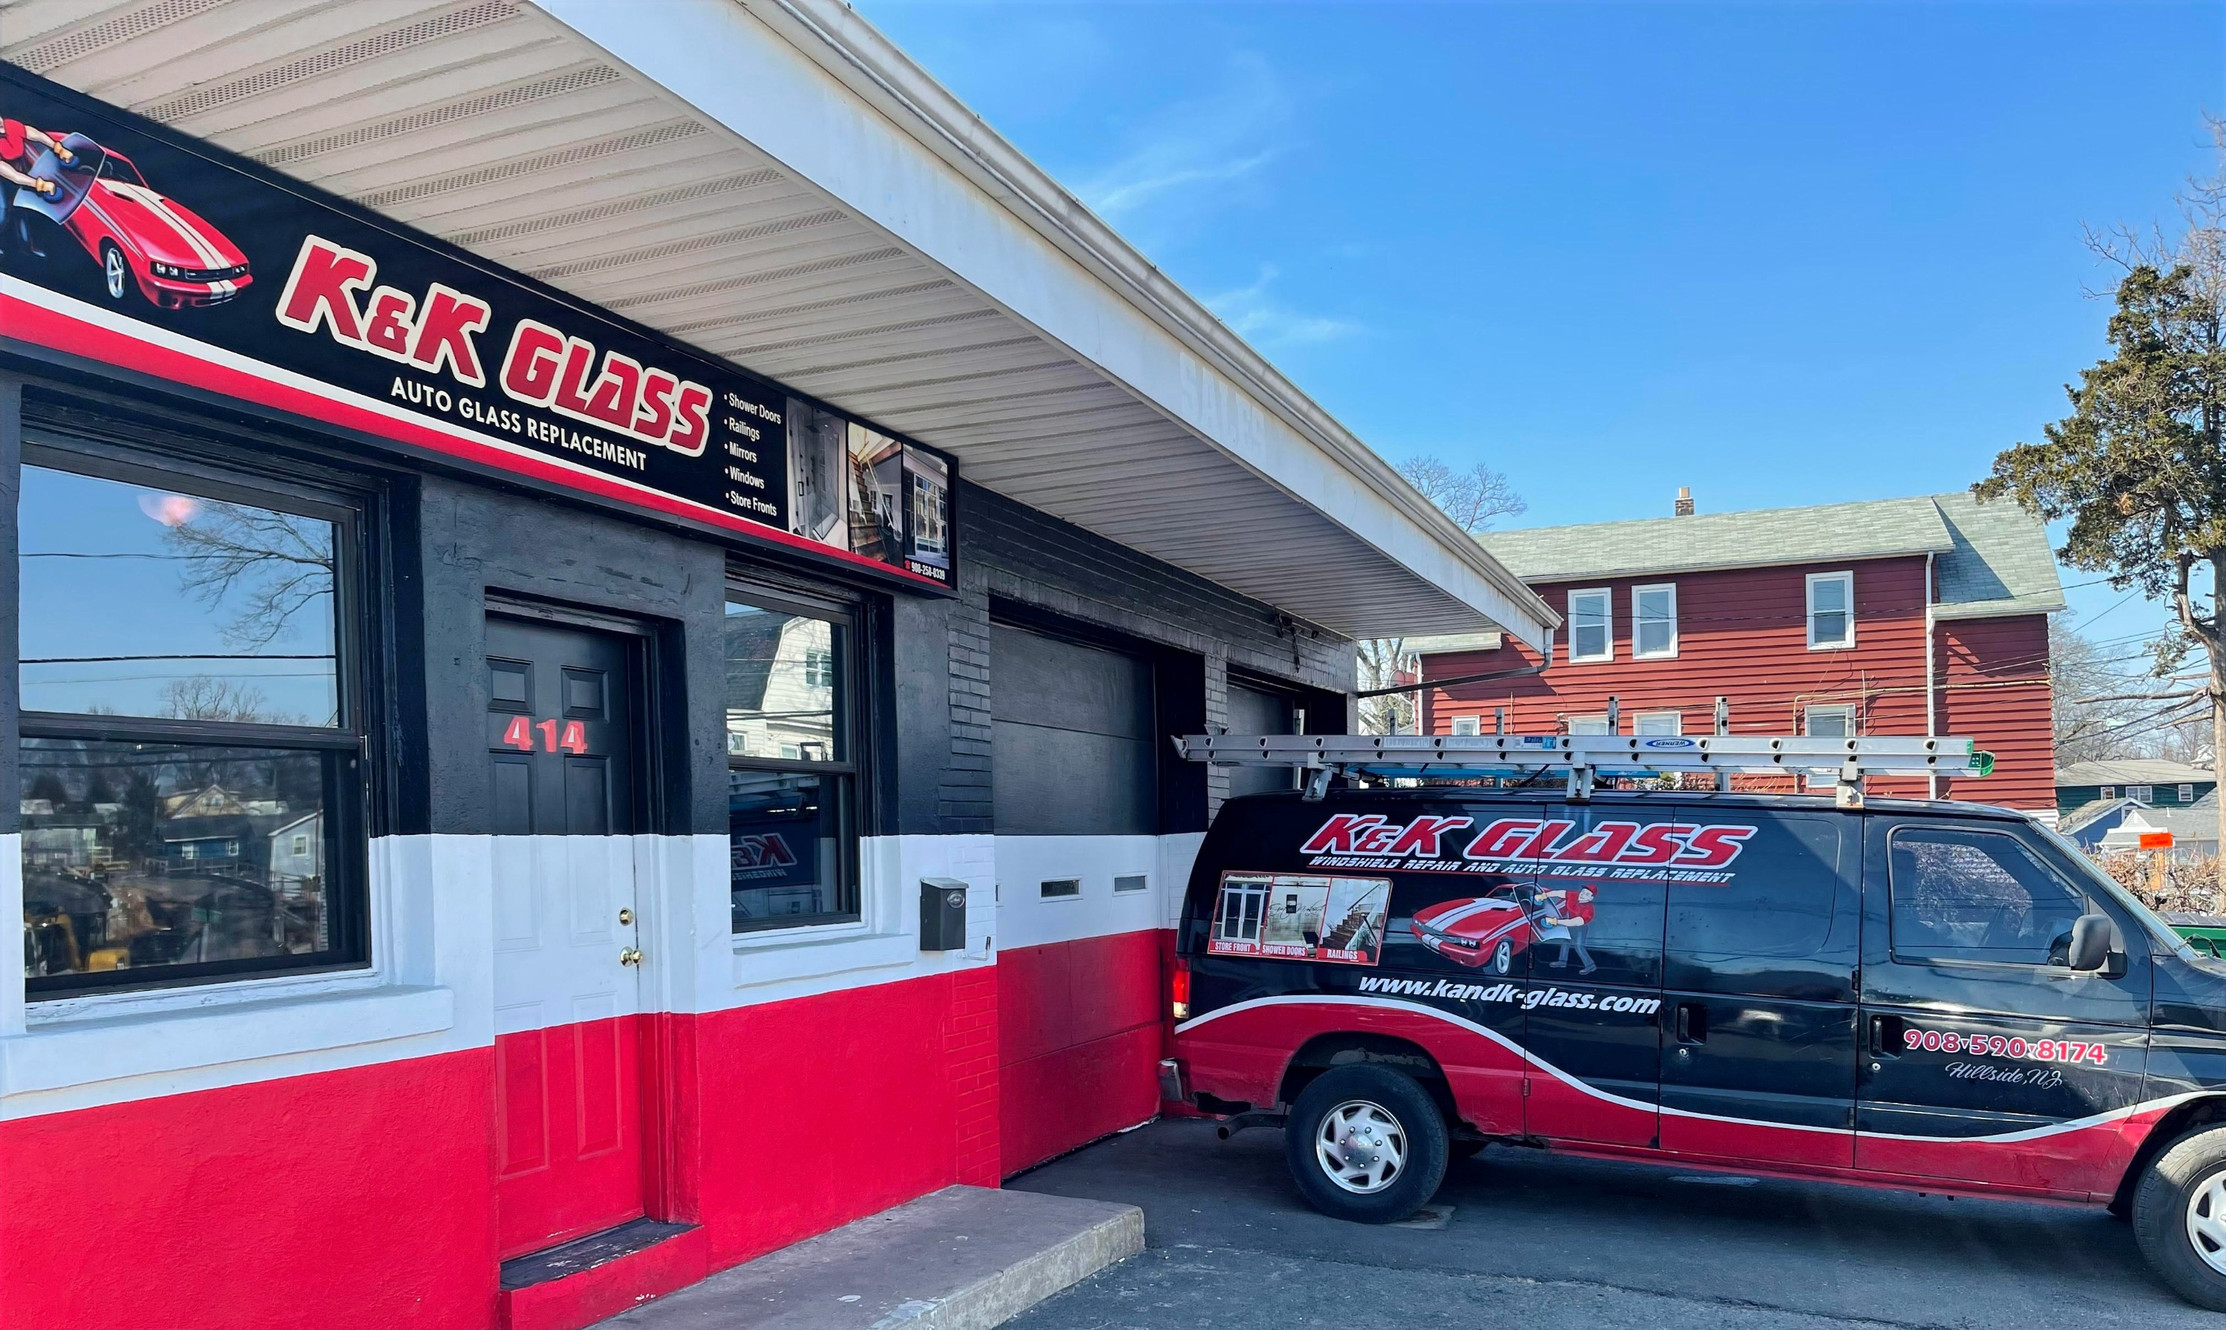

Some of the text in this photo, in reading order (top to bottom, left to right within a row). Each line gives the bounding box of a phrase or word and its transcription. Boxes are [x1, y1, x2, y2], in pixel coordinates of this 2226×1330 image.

[275, 234, 714, 458] K&K GLASS
[729, 392, 782, 425] Shower Doors
[391, 376, 647, 472] AUTO GLASS REPLACEMENT
[729, 416, 760, 442] Railings
[729, 441, 757, 463] Mirrors
[729, 465, 765, 489] Windows
[730, 490, 777, 517] Store Fronts
[504, 715, 588, 755] 414
[1300, 813, 1758, 870] K&K GLASS
[1308, 856, 1736, 884] WINDSHIELD REPAIR AND AUTO GLASS REPLACEMENT
[1215, 942, 1251, 953] STORE FRONT
[1262, 945, 1286, 956] SHOWER
[1326, 948, 1358, 960] RAILINGS
[1358, 976, 1662, 1015] www.kandk-glass.com
